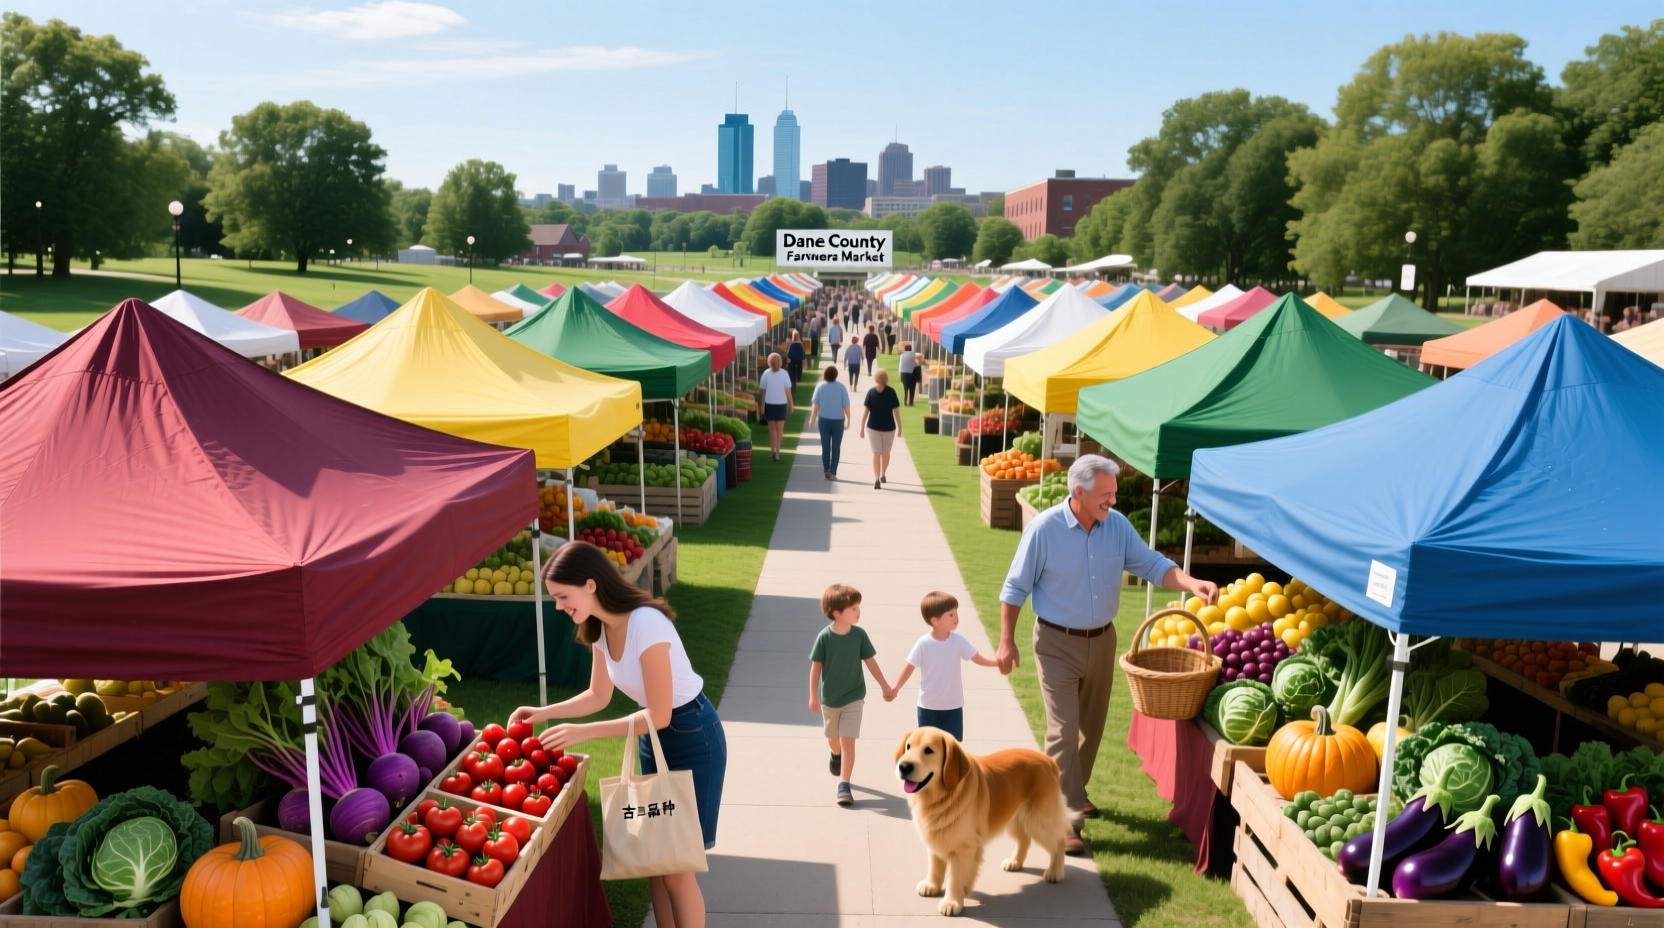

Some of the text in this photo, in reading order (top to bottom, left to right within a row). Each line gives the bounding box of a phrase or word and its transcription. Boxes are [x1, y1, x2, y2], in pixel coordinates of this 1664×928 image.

[783, 233, 886, 252] Dane County
[841, 250, 885, 262] Market
